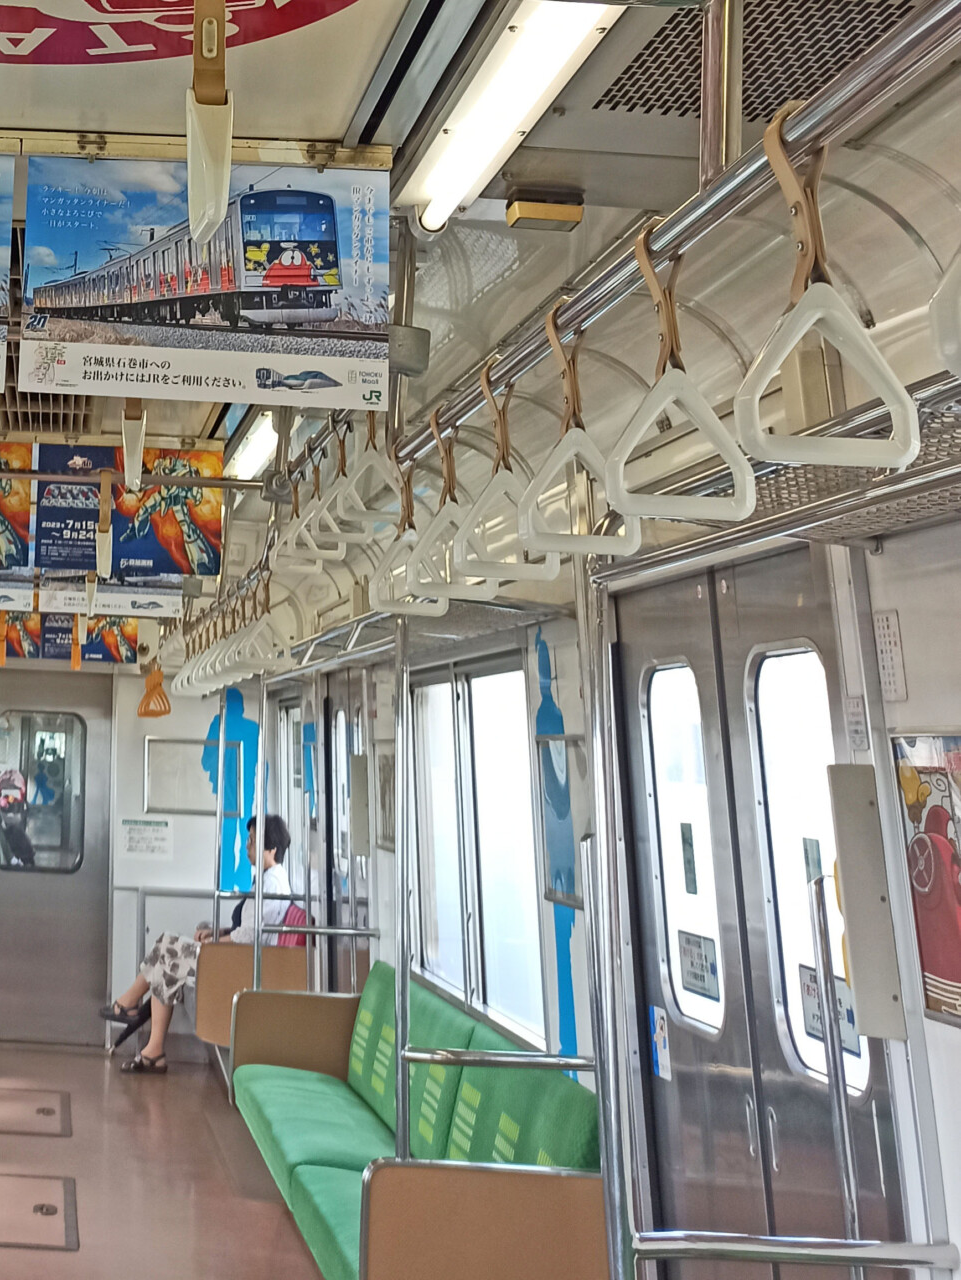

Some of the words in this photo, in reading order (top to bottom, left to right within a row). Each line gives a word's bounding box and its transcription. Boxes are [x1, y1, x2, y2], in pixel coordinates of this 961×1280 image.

[82, 355, 171, 370] 宮城県石巻市への
[81, 369, 247, 389] お出かけにはJRをご利用ください。
[362, 390, 382, 402] JR
